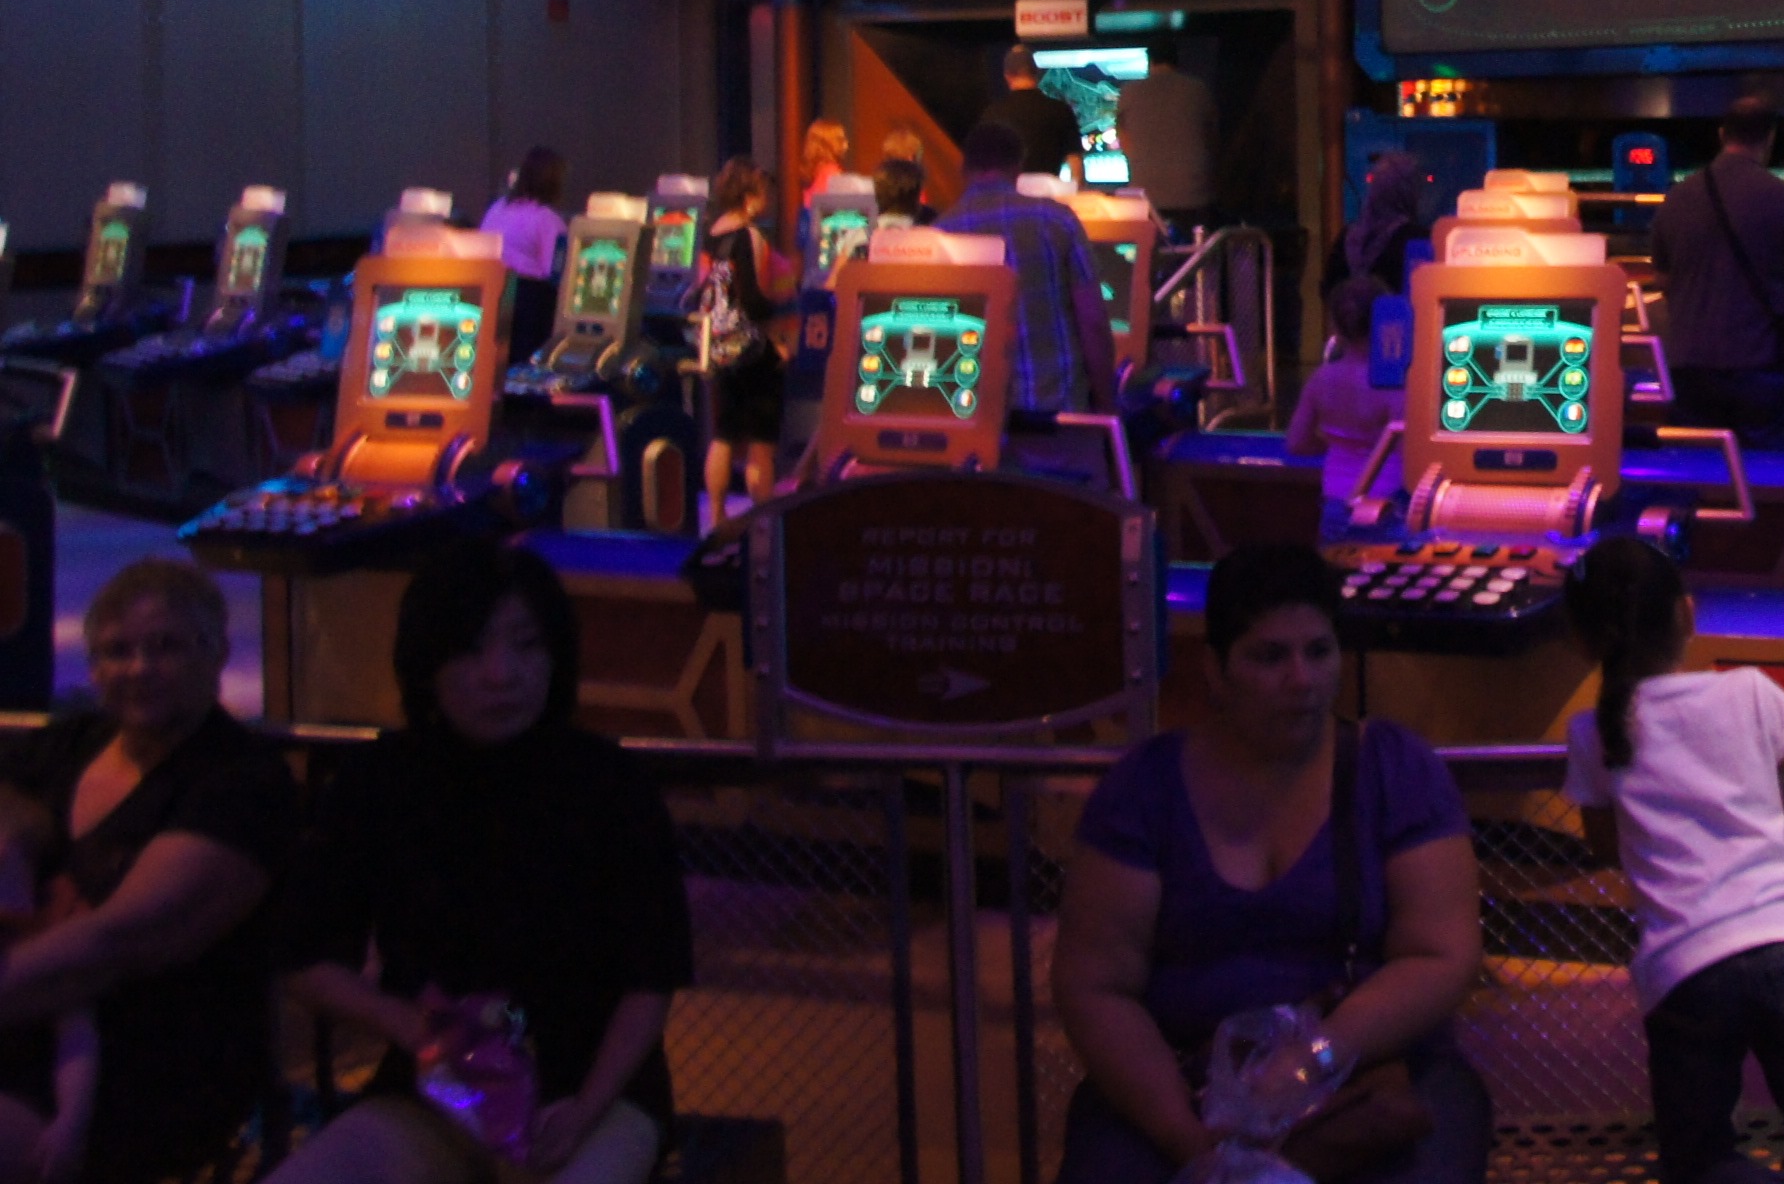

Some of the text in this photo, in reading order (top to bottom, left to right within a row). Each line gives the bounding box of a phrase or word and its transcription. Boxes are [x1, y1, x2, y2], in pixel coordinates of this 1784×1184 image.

[1020, 8, 1083, 25] BOOST
[861, 527, 1037, 547] REPORT FOR
[838, 579, 1065, 605] SPACE RACE
[820, 614, 1085, 634] MISSION CONTROL
[888, 634, 1019, 654] TRAINING
